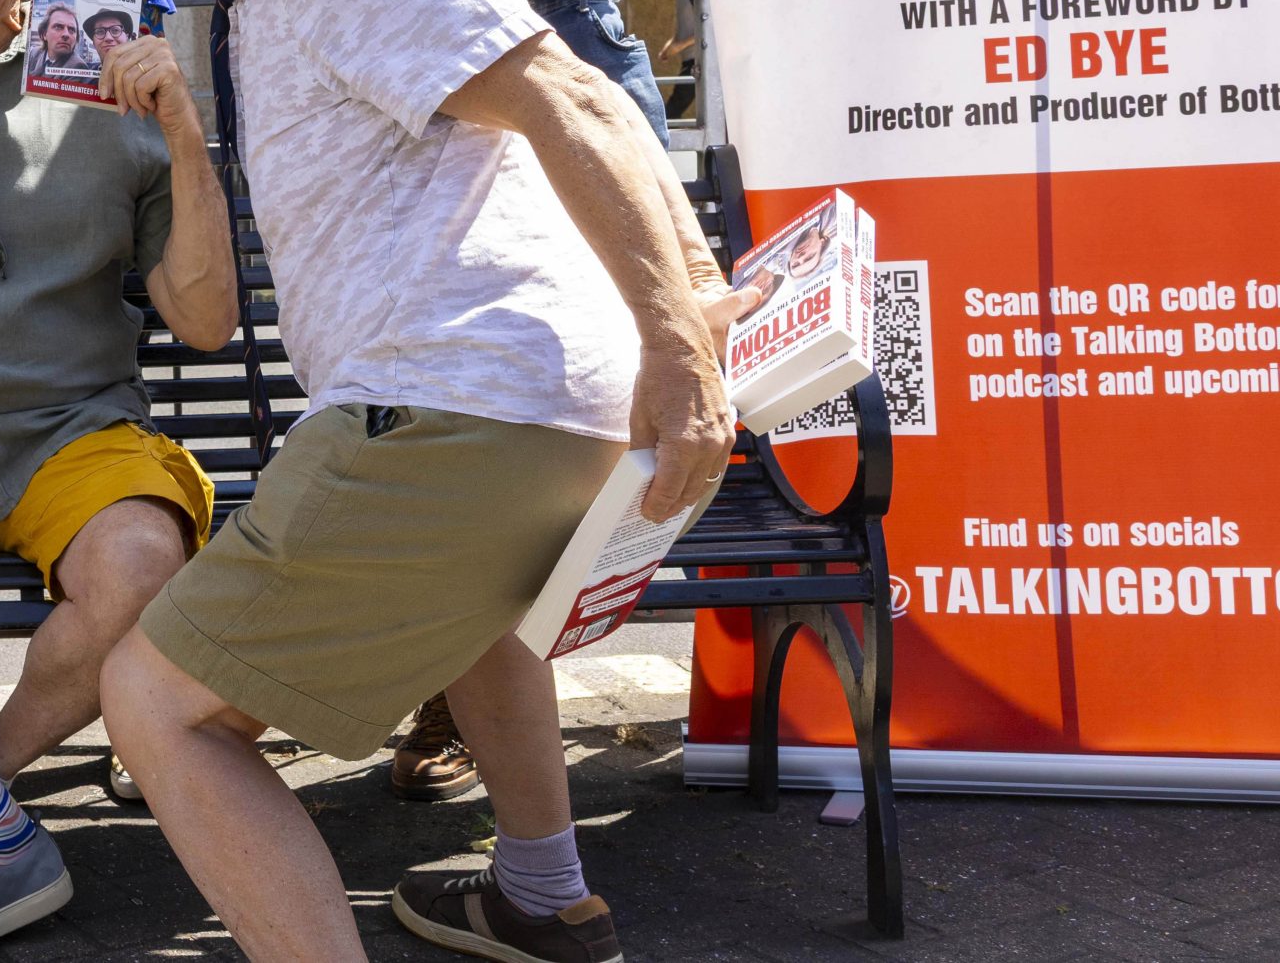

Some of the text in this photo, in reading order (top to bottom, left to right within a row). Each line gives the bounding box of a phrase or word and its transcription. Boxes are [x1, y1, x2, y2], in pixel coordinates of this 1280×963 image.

[984, 27, 1168, 84] ED BYE
[848, 83, 1280, 134] Director and Producer of Bott
[964, 279, 1280, 317] Scan the QR code fo
[731, 286, 831, 369] BOTTOM
[967, 322, 1280, 358] on the Talking Botto
[970, 362, 1280, 401] podcast and upcomi
[964, 517, 1239, 547] Find us on socials
[890, 566, 1280, 621] TALKINGBOTT
